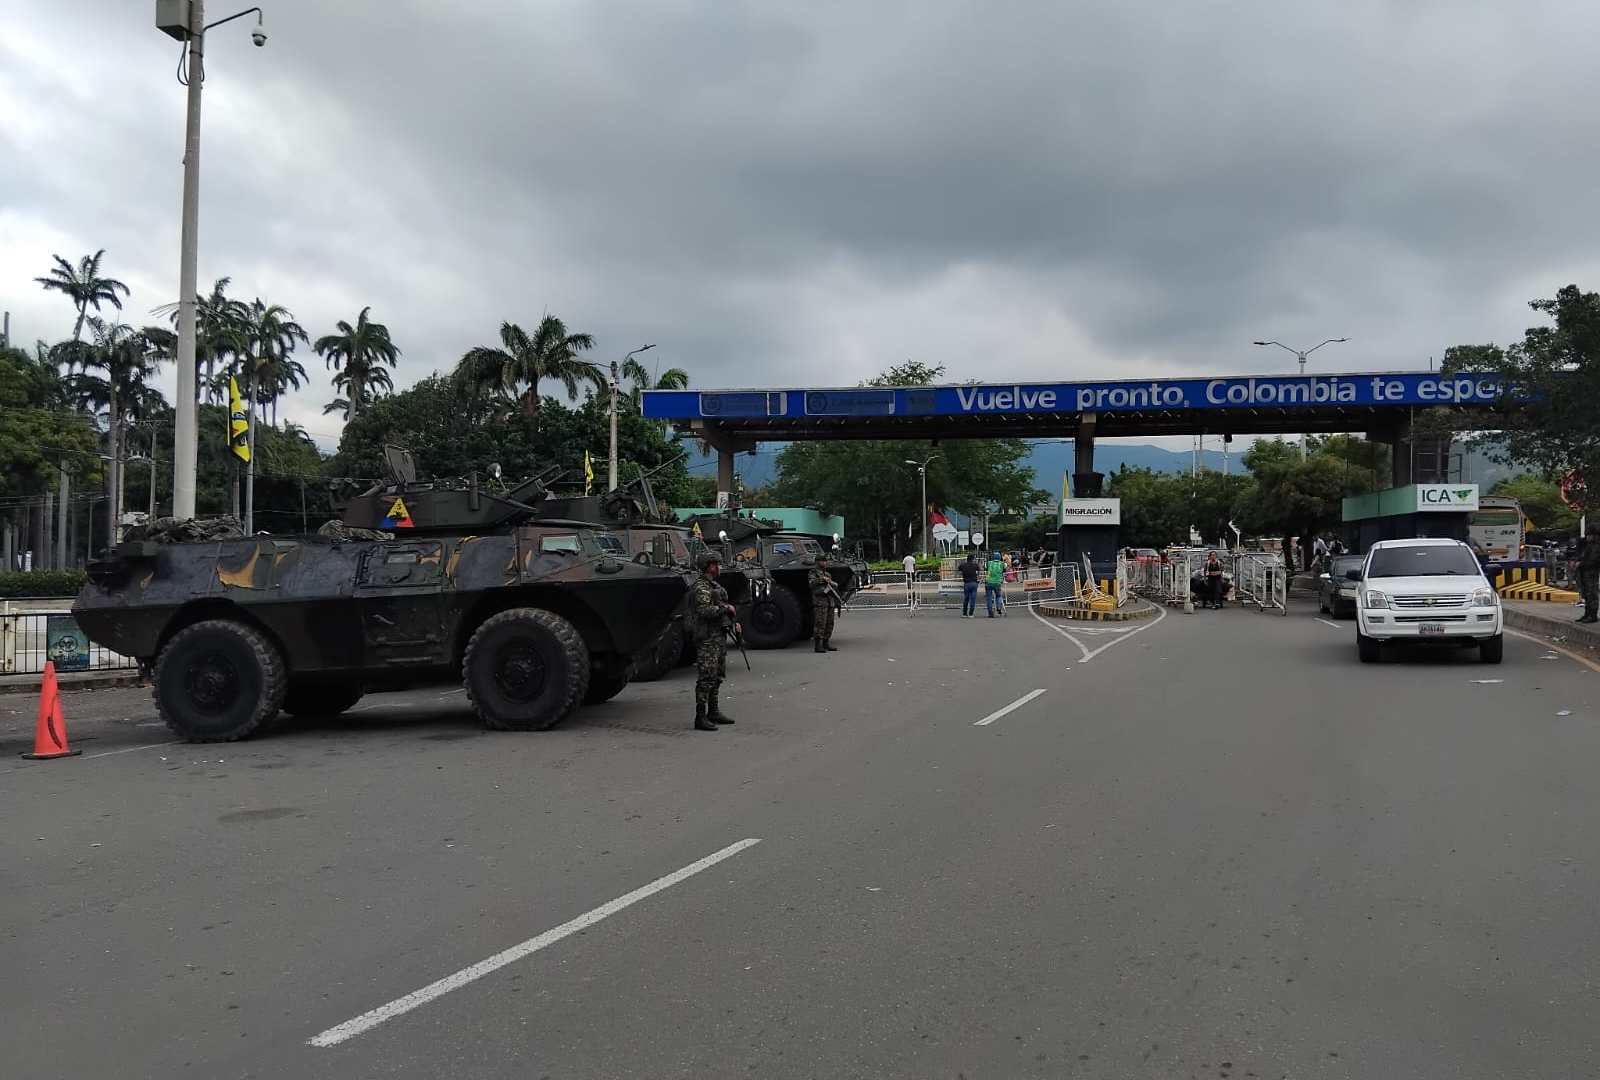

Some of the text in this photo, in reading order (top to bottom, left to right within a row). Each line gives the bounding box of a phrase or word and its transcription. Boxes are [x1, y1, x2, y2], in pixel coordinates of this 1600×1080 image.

[956, 386, 1057, 411] Vuelve
[1206, 377, 1356, 404] Colombia
[1371, 377, 1405, 400] te
[1417, 379, 1528, 404] espe
[1422, 489, 1451, 502] ICA
